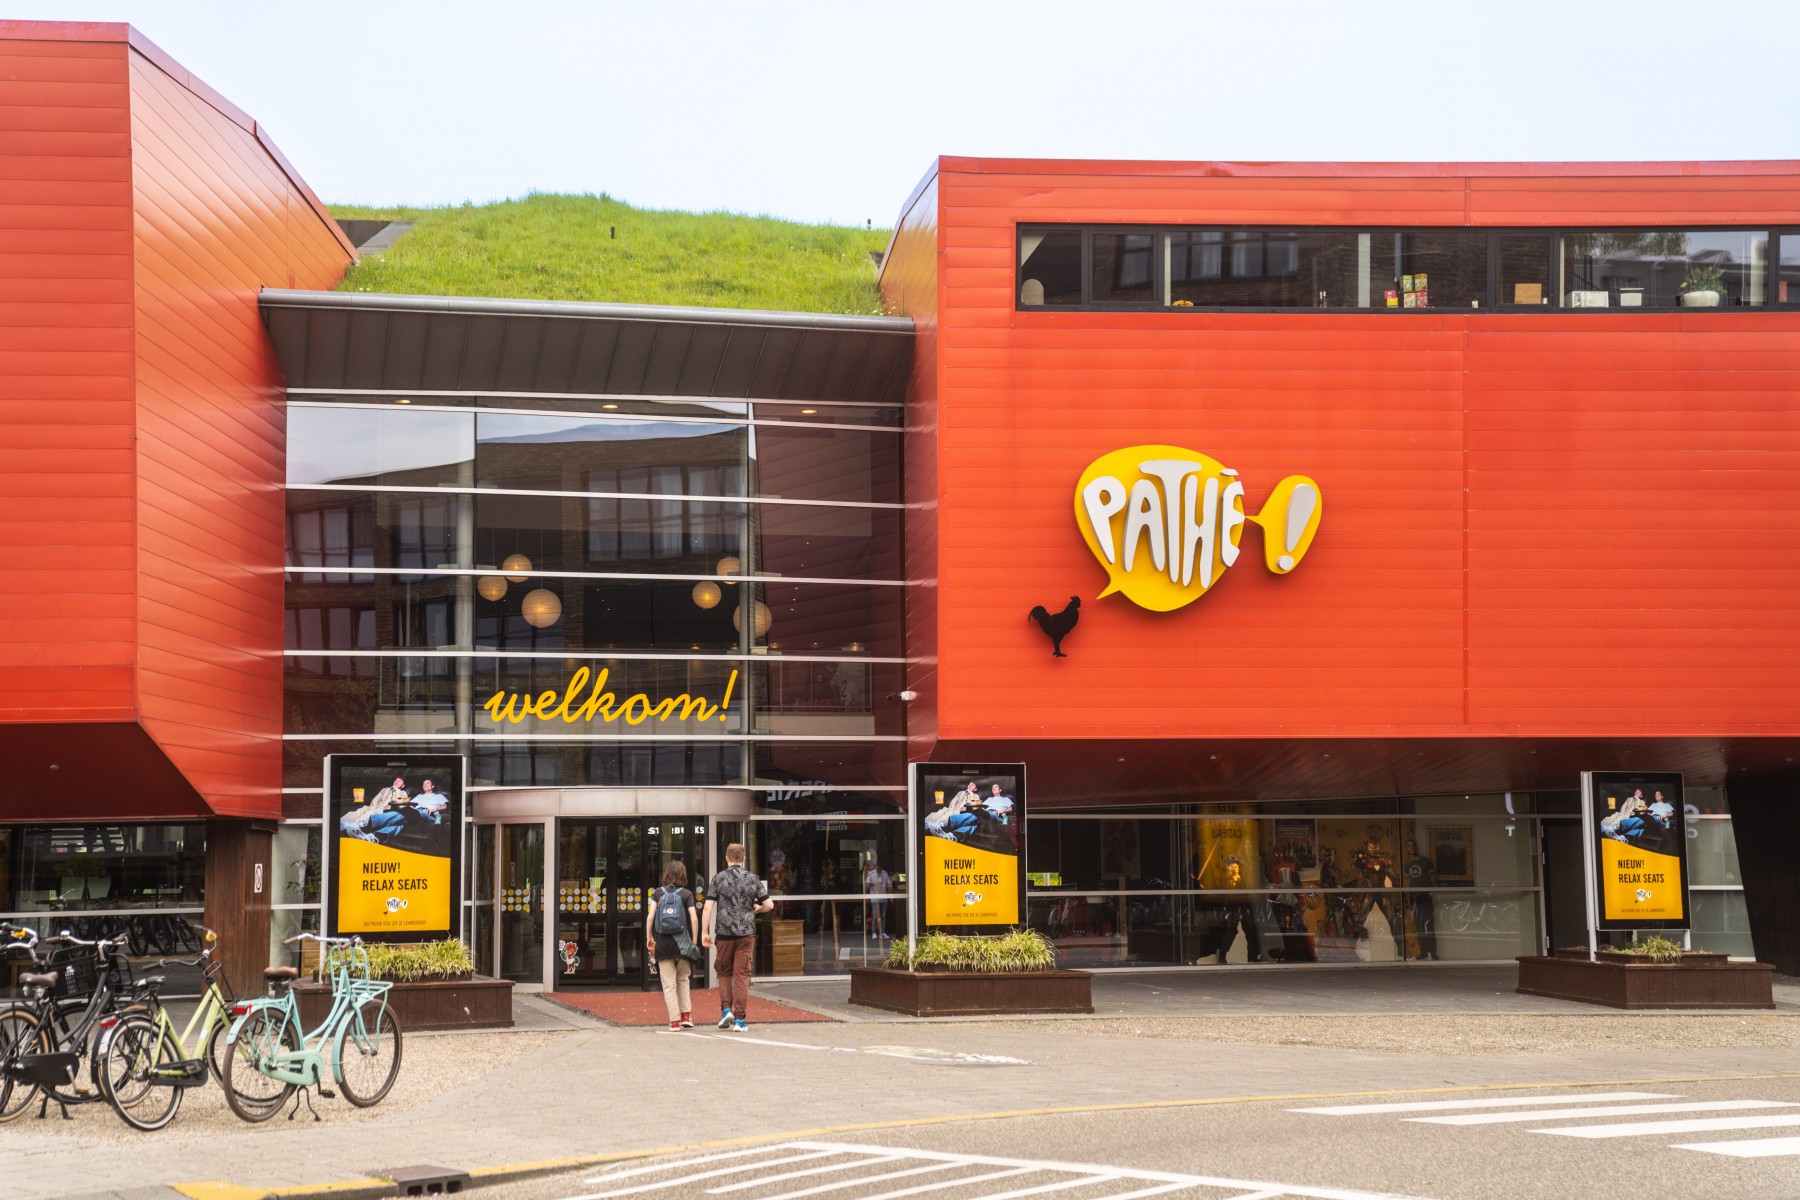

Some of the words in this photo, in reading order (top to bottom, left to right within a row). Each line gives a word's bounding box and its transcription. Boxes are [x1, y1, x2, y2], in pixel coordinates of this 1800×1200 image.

[483, 666, 738, 725] welkom!
[647, 825, 705, 835] STBUKS
[362, 862, 401, 874] NIEUW!
[944, 859, 975, 869] NIEUW!
[1618, 859, 1645, 869] NIEUW!
[944, 874, 970, 885] RELAX
[973, 874, 998, 884] SEATS
[1618, 874, 1641, 883] RELAX
[1643, 873, 1664, 883] SEATS
[362, 879, 394, 891] RELAX
[397, 878, 428, 890] SEATS
